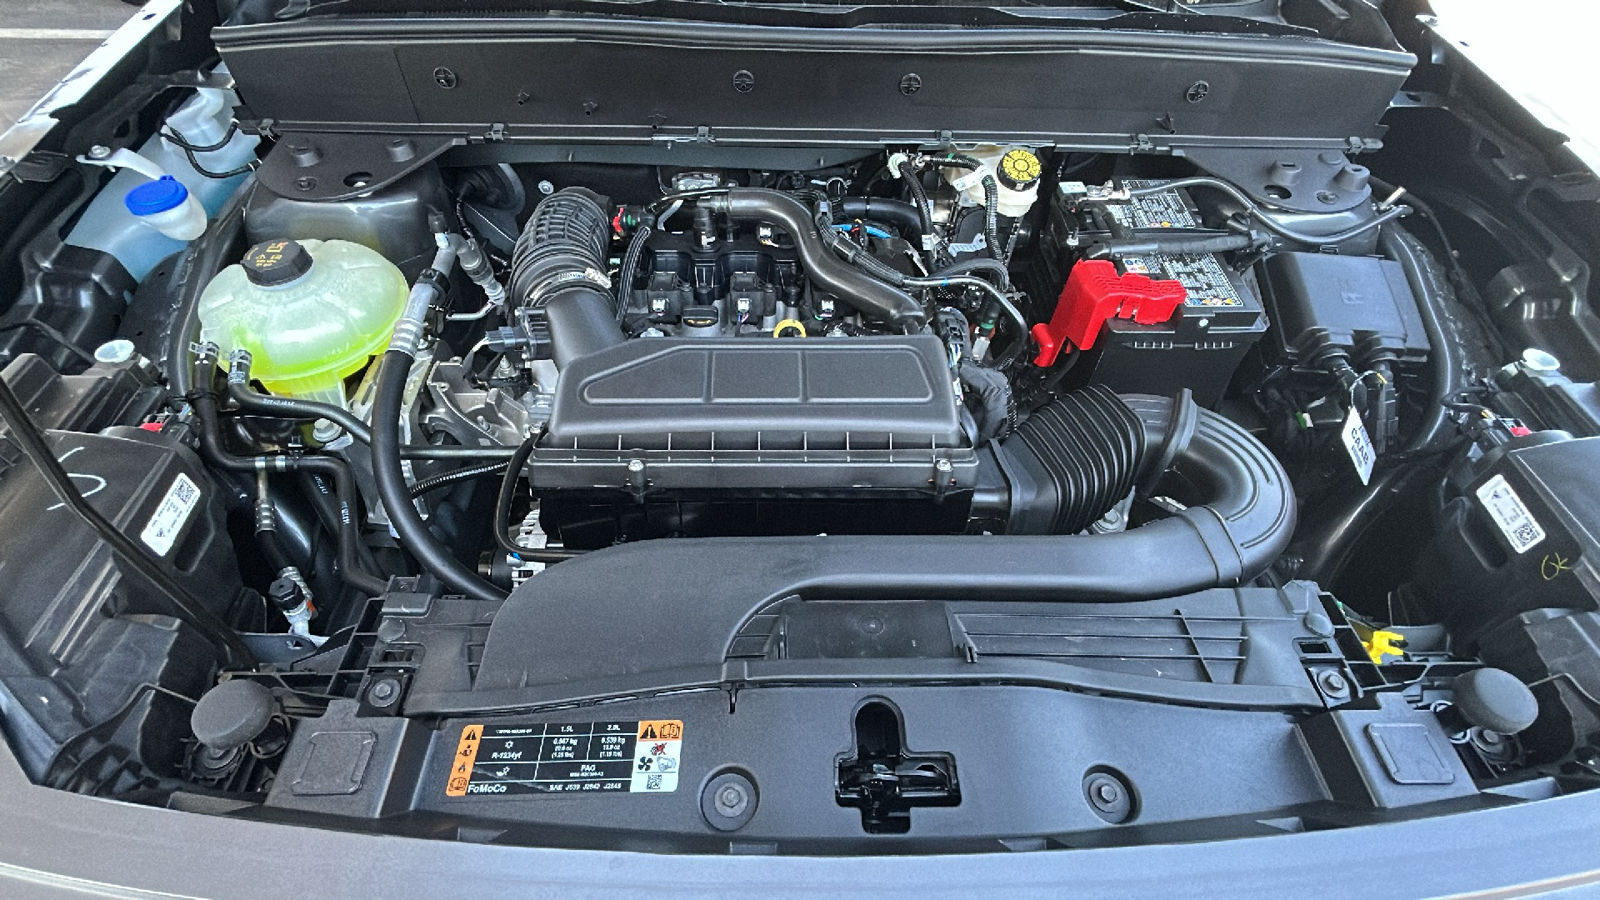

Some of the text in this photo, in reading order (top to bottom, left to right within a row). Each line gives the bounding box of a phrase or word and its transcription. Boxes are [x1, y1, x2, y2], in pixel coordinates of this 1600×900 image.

[561, 725, 574, 733] 1.5L
[570, 738, 578, 746] kg
[618, 737, 626, 745] kg
[491, 751, 522, 760] R-1234yf
[467, 783, 507, 793] FoMoCo
